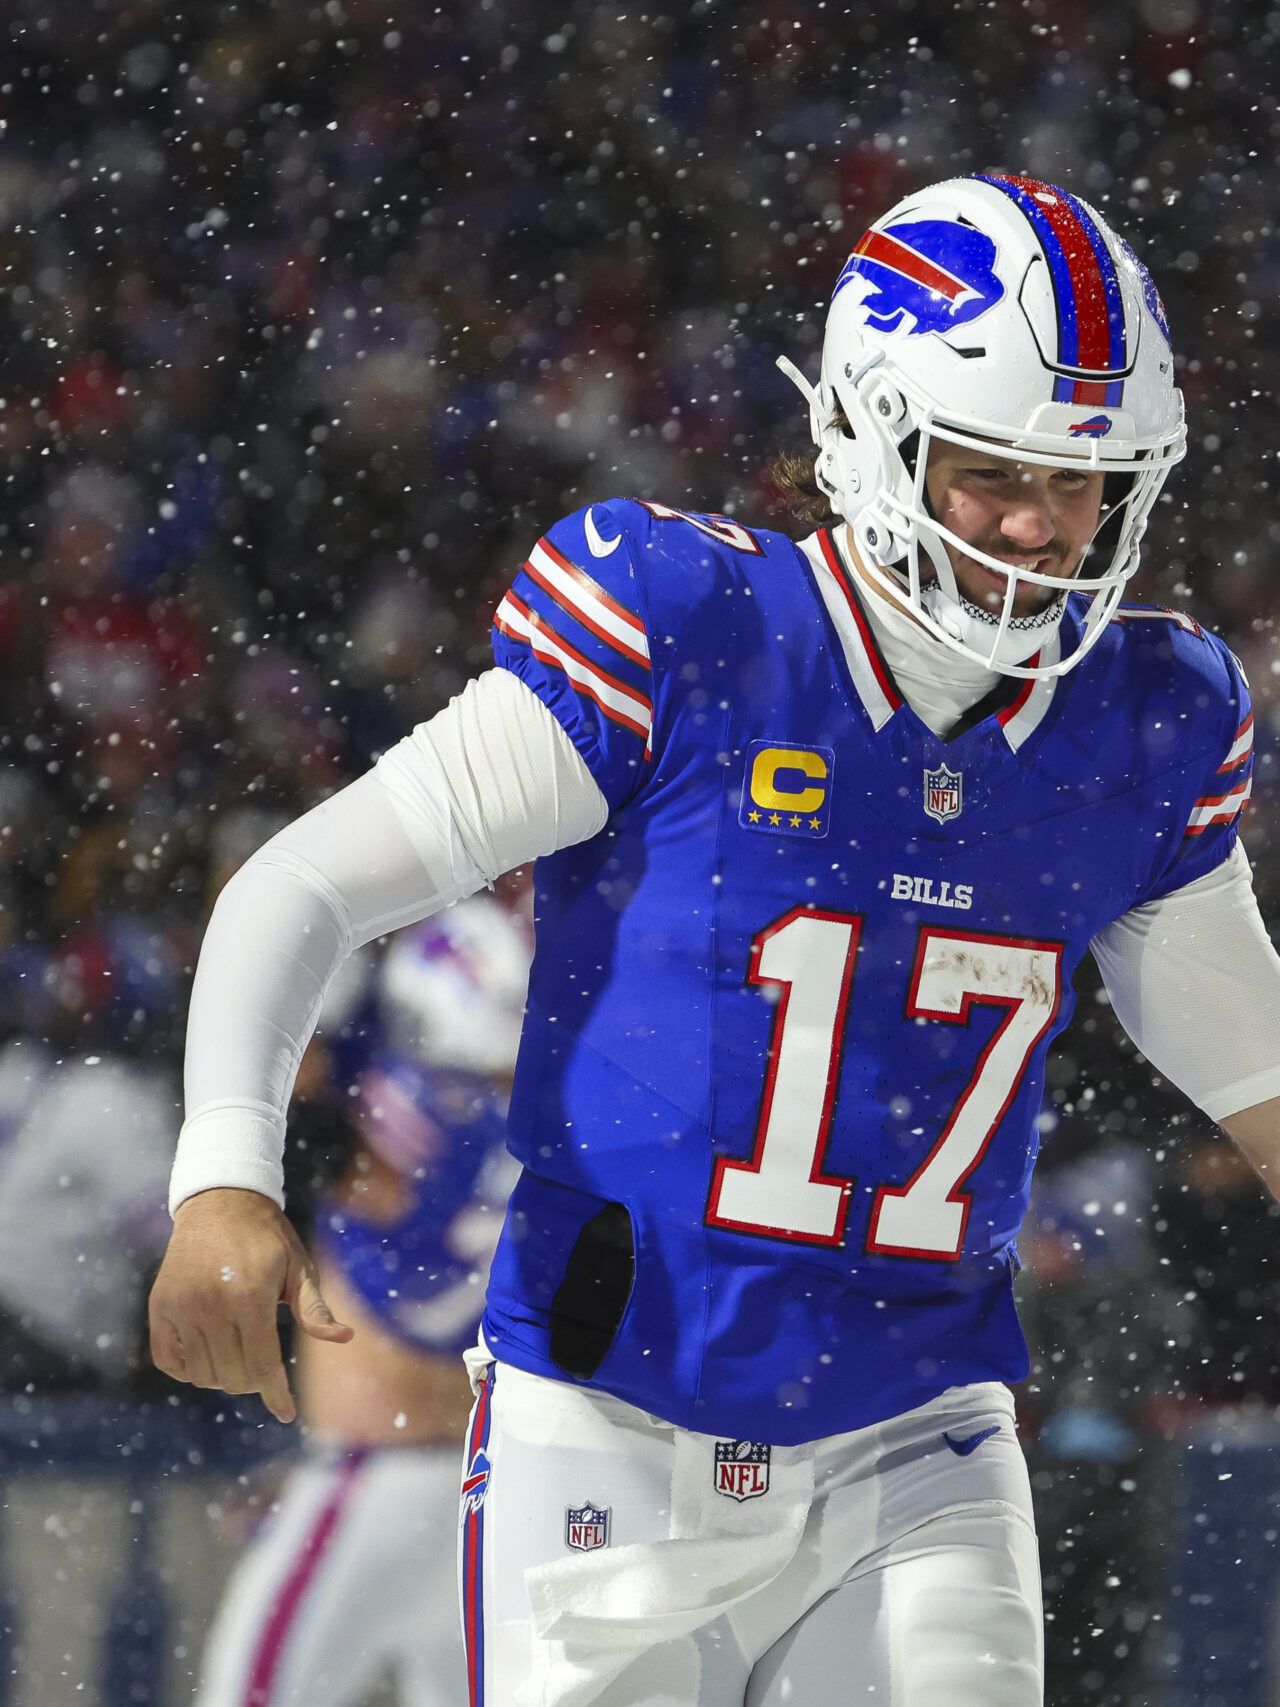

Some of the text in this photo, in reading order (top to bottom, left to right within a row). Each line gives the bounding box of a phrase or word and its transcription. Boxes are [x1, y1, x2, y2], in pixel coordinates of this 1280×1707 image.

[750, 748, 828, 813] C
[930, 791, 957, 813] NFL
[891, 873, 973, 910] BILLS
[704, 903, 1066, 1262] 17
[718, 1464, 765, 1496] NFL
[570, 1525, 603, 1546] NFL
